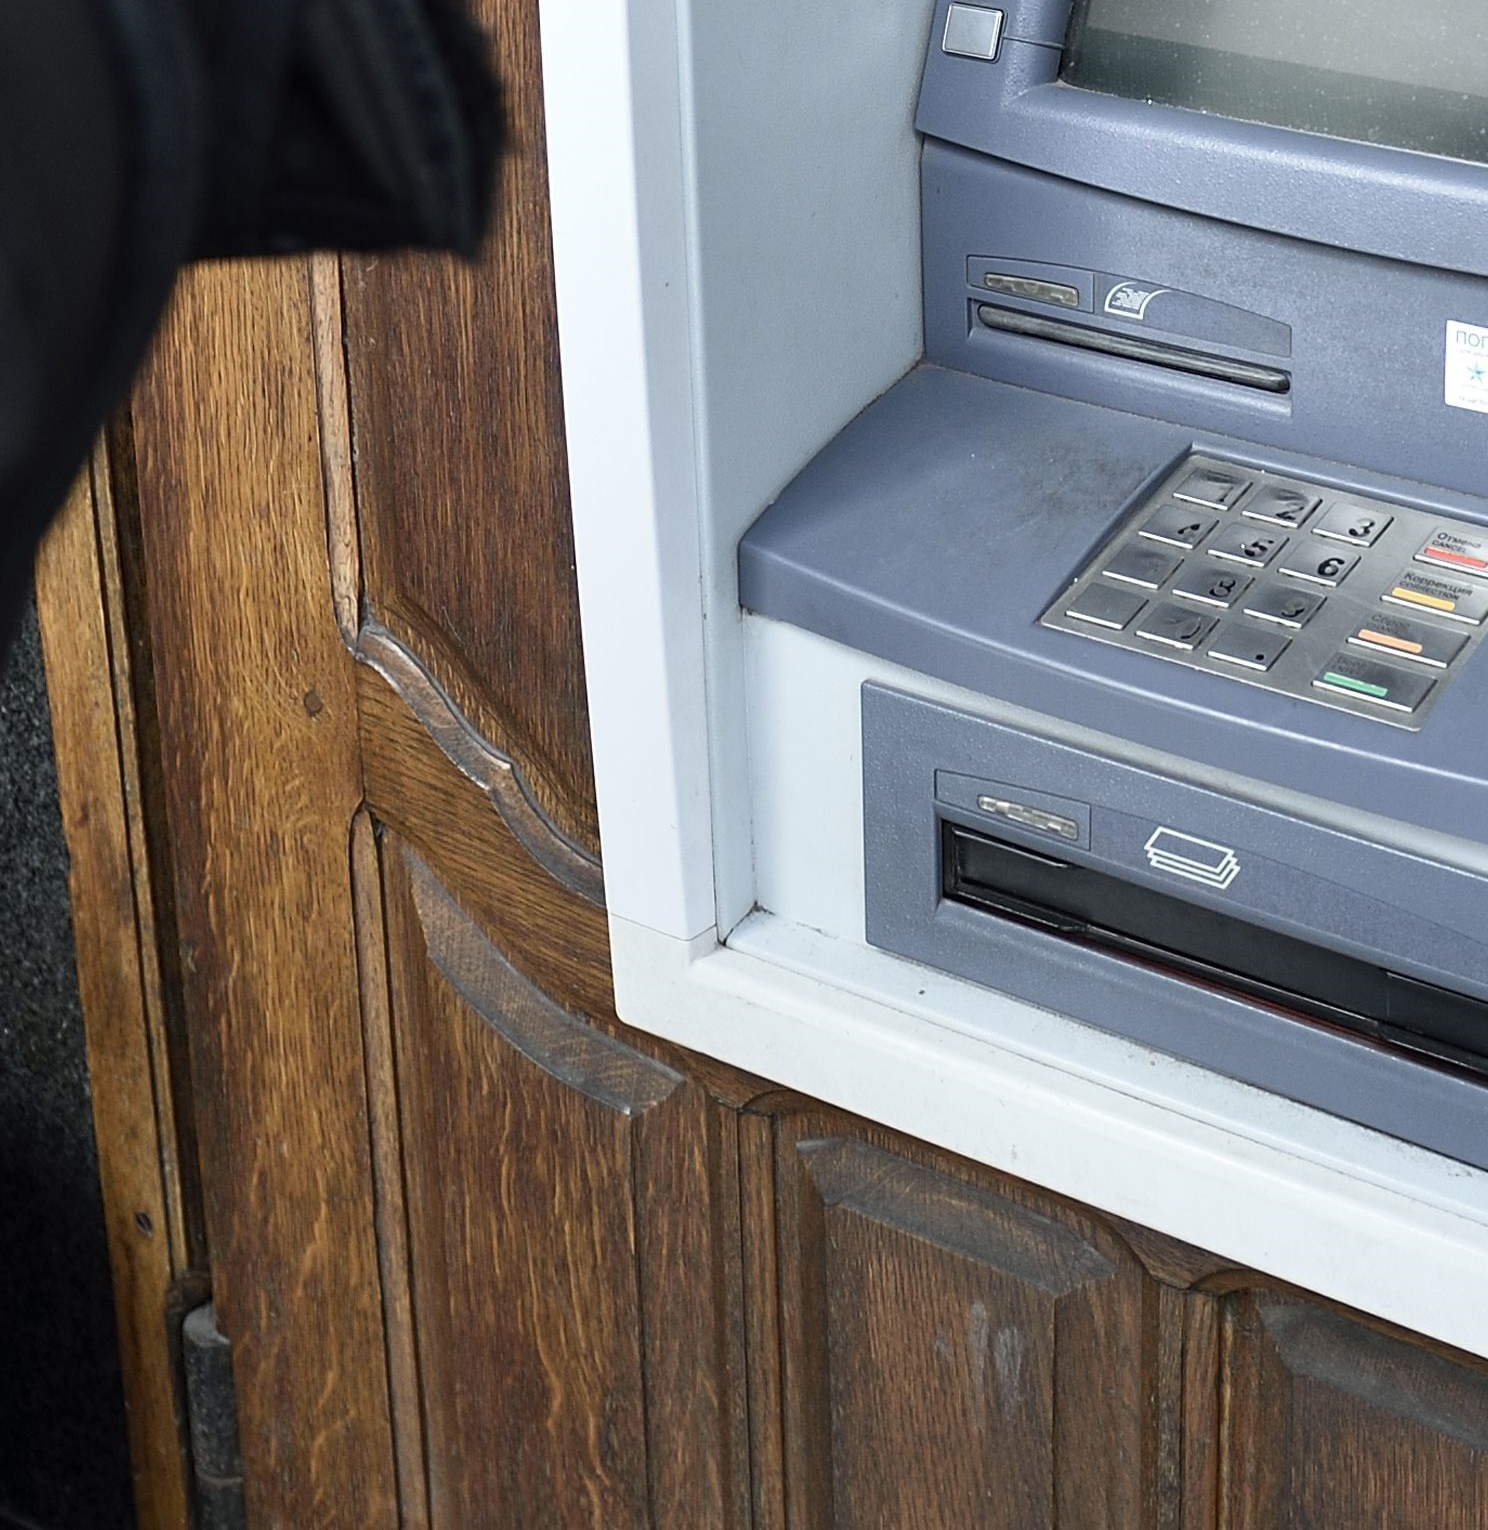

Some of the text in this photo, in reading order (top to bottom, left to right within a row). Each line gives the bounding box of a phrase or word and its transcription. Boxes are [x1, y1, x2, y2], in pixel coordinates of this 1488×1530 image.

[1348, 517, 1376, 538] 3
[1317, 557, 1346, 578] 6
[1404, 571, 1474, 597] Коррекция
